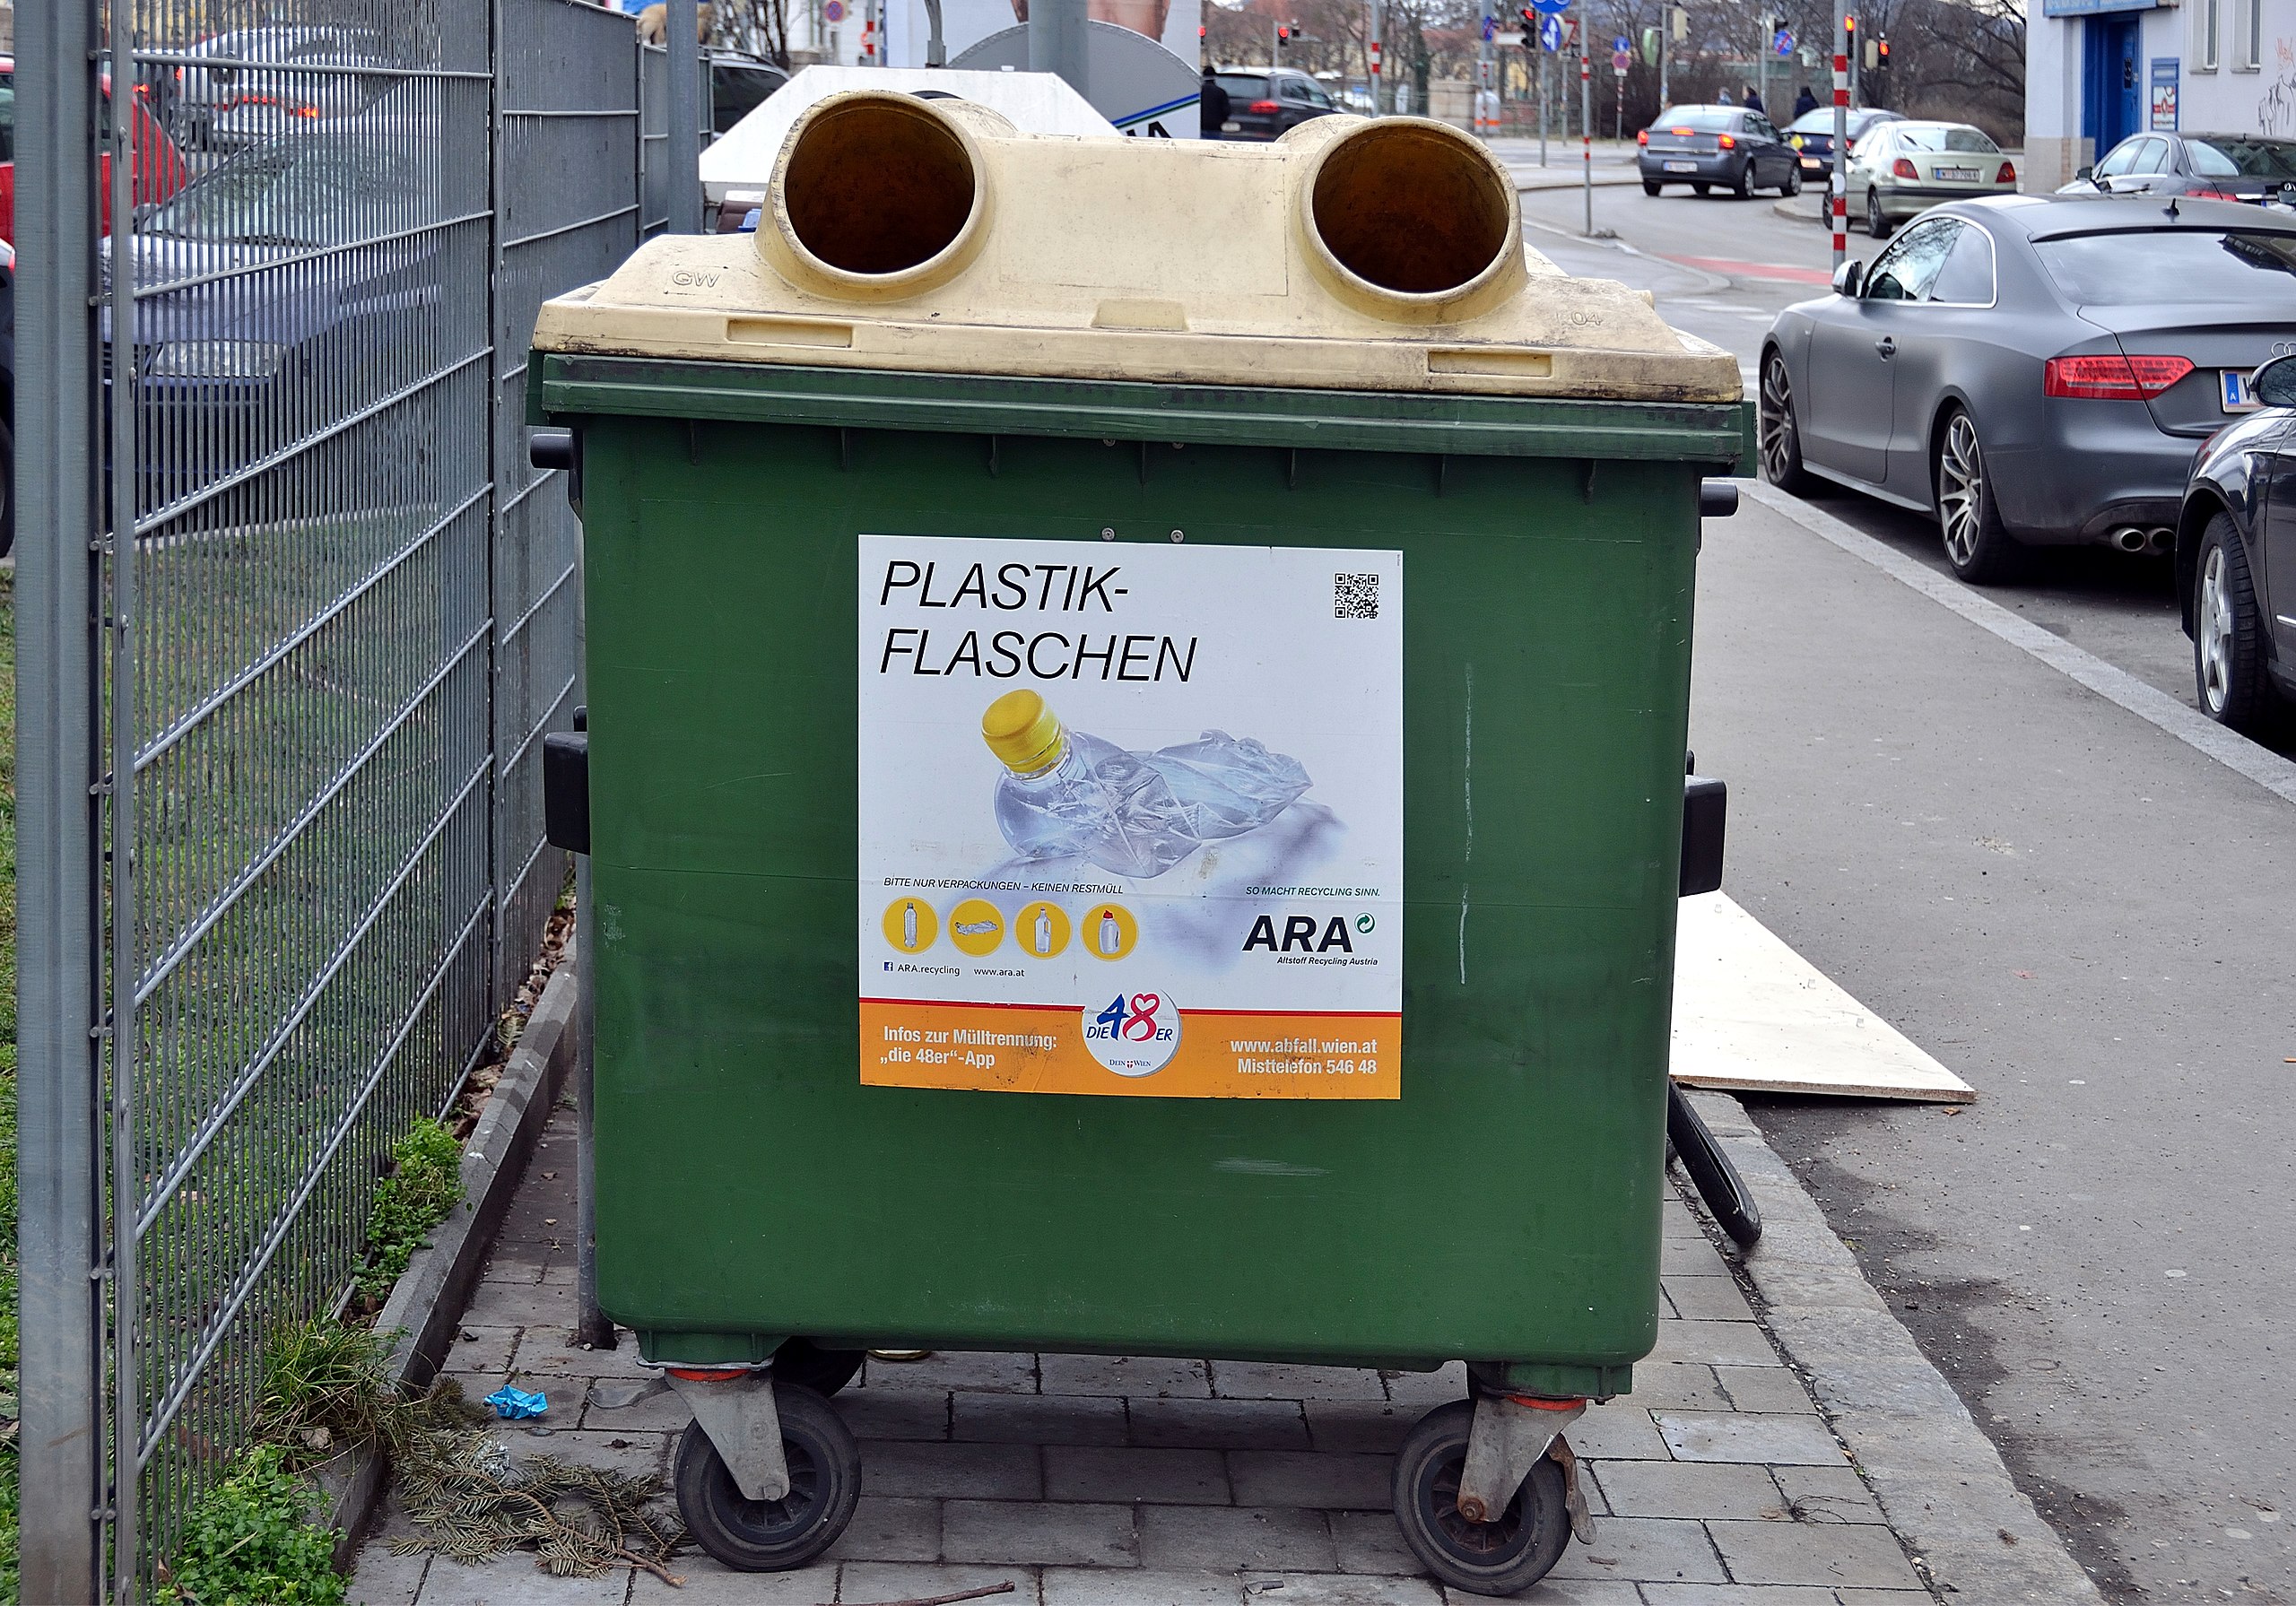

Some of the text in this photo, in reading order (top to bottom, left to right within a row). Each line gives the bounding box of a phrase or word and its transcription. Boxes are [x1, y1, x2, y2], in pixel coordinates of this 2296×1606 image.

[672, 270, 721, 288] GW
[2230, 392, 2237, 401] A
[880, 560, 1129, 612] PLASTIK-
[880, 628, 1198, 682] FLASCHEN
[883, 877, 911, 888] BITTE
[913, 879, 936, 889] NUR
[937, 880, 1022, 891] VERPACKUNGEN
[1031, 882, 1070, 893] KEINEN
[1072, 884, 1123, 895] RESTMÜLL
[1246, 886, 1380, 897] SO MACHT RECYCLING SINN.
[1242, 915, 1353, 953] ARA
[1277, 956, 1378, 967] Altstoff Recycling Austria
[897, 964, 961, 977] ARA.recycling
[974, 968, 1025, 977] www.ara.at
[883, 1026, 1058, 1051] Infos zur Mülltrennung:
[1086, 1026, 1110, 1039] DIE
[1231, 1037, 1378, 1054] www.abfall.wien.at
[1238, 1057, 1378, 1074] Misttelefon 546 48
